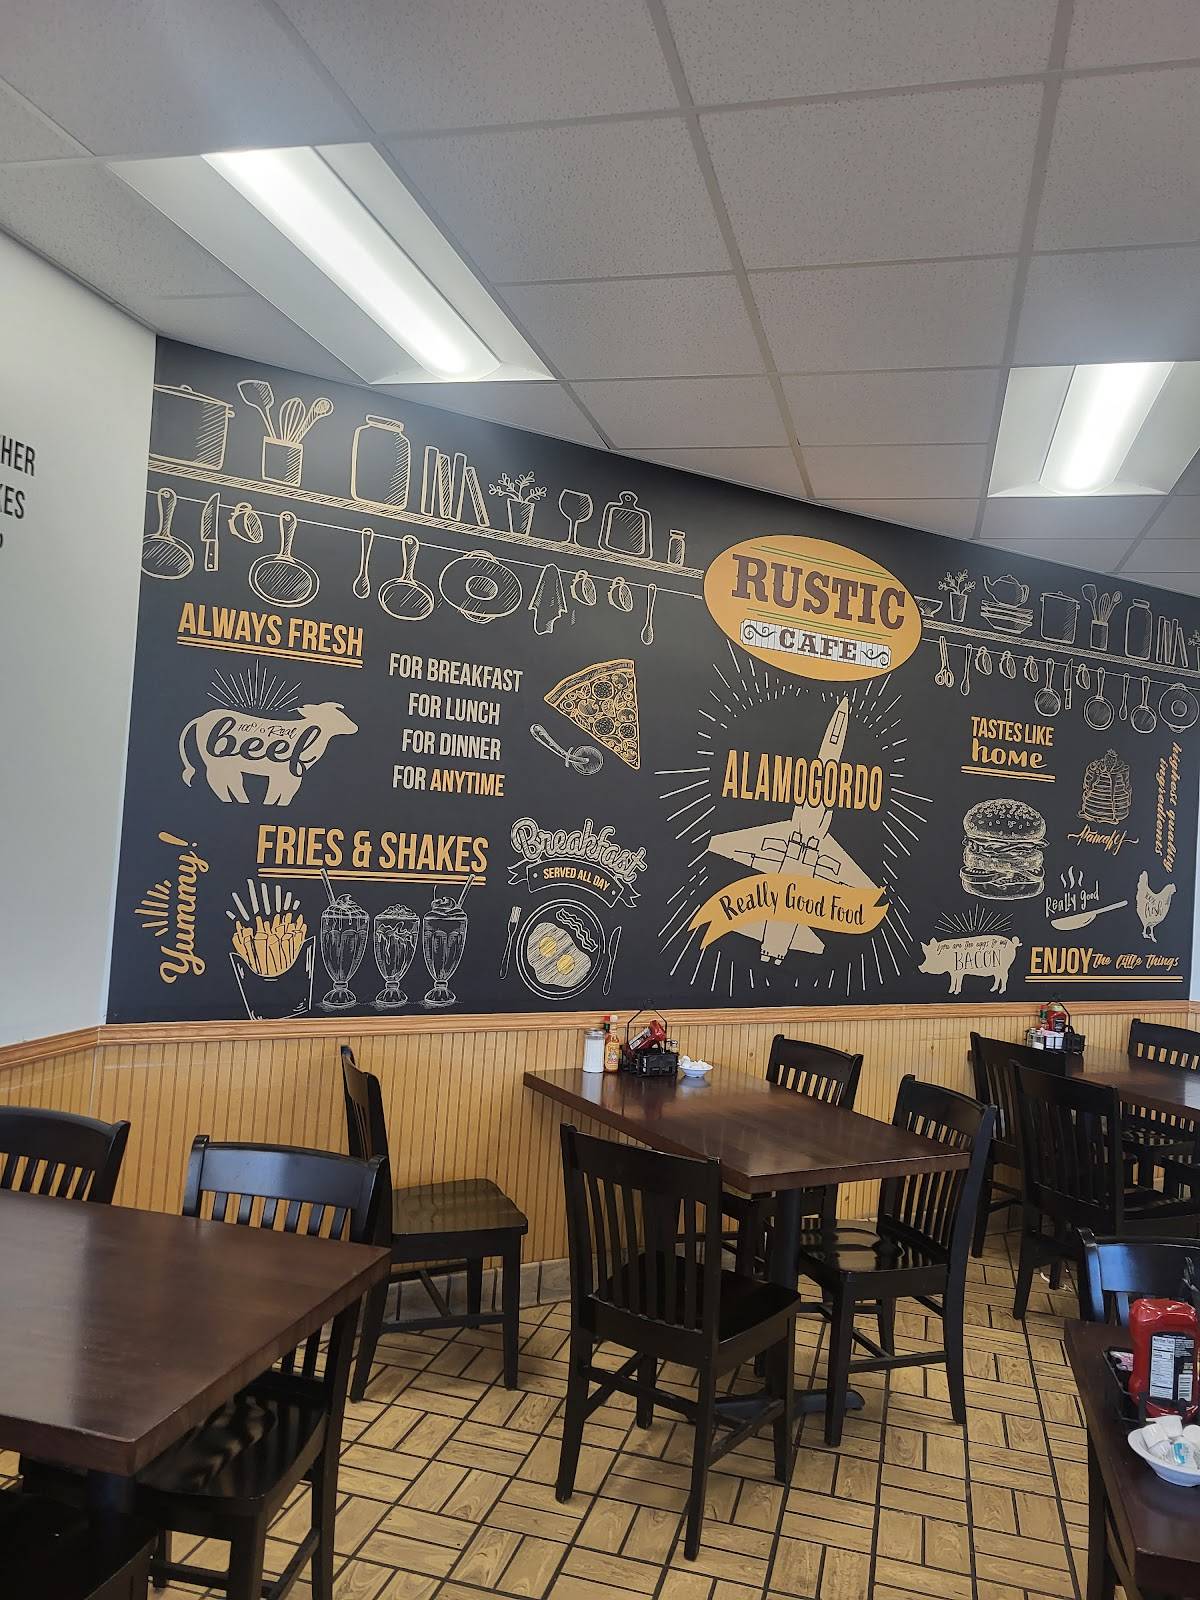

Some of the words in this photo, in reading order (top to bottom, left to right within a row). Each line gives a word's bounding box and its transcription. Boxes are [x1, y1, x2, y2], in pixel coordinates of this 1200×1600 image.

[0, 433, 35, 476] HER
[0, 483, 25, 519] ES
[731, 554, 906, 630] RUSTIC
[178, 602, 282, 646] ALWAYS
[288, 617, 363, 657] FRESH
[778, 628, 857, 661] CAFE
[388, 652, 423, 680] FOR
[427, 657, 523, 692] BREAKFAST
[408, 692, 441, 719] FOR
[445, 697, 500, 725] LUNCH
[206, 716, 322, 778] beef
[267, 725, 298, 740] Real
[401, 729, 434, 755] FOR
[440, 733, 501, 761] DINNER
[971, 716, 1022, 743] TASTES
[1024, 723, 1055, 747] LIKE
[971, 738, 1047, 769] home
[1168, 742, 1182, 806] highest
[392, 765, 426, 791] FOR
[430, 769, 505, 797] ANYTIME
[721, 749, 884, 812] ALAMOGORDO
[1155, 758, 1168, 857] ingredients
[256, 824, 344, 867] FRIES
[352, 830, 371, 867] &
[379, 831, 489, 873] SHAKES
[511, 817, 647, 883] Breakfast
[1163, 809, 1177, 873] quality
[543, 867, 576, 880] SERVED
[578, 869, 592, 883] ALL
[593, 875, 611, 892] DAY
[158, 831, 210, 984] Yummy!
[719, 881, 779, 921] Really
[785, 883, 826, 918] Good
[830, 896, 866, 926] Food
[954, 949, 1002, 972] BACON
[1030, 946, 1093, 974] ENJOY
